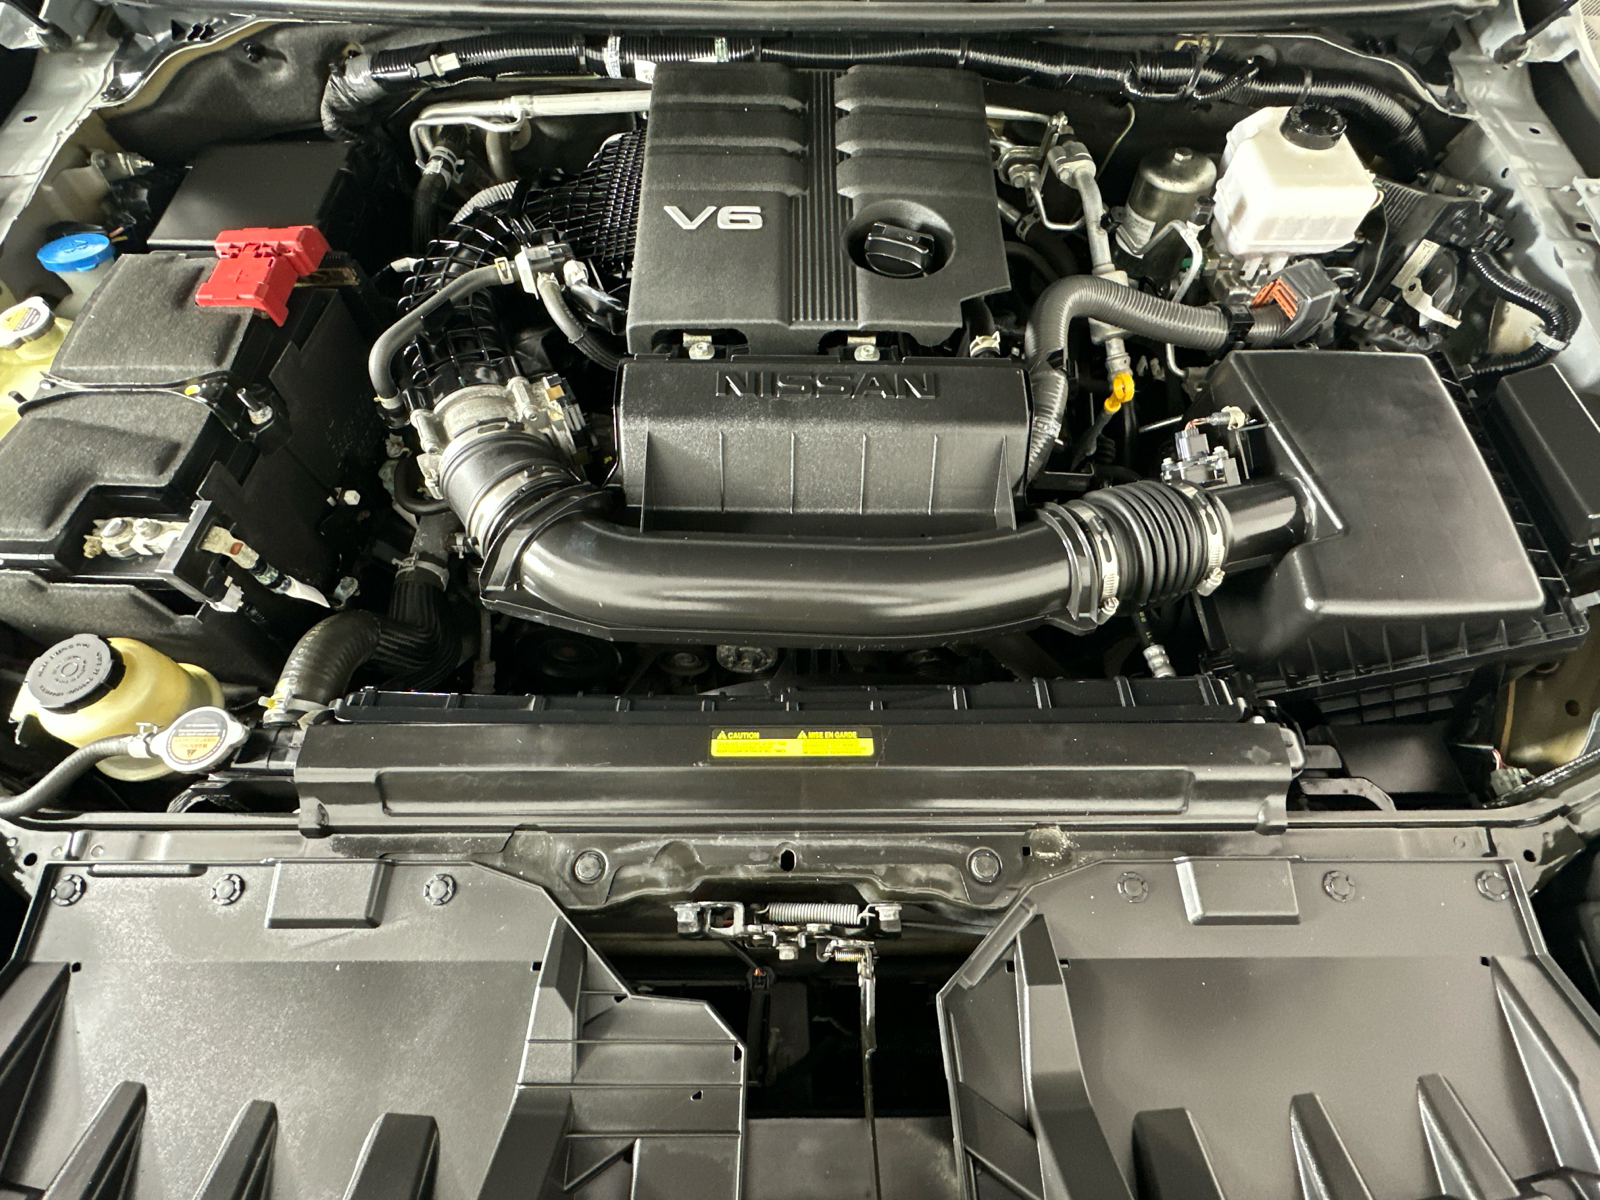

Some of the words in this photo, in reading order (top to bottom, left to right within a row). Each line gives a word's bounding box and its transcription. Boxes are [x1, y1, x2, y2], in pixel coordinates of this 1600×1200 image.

[663, 205, 763, 230] V6
[715, 370, 936, 400] NISSAN
[727, 731, 760, 739] CAUTION
[808, 731, 824, 739] MISE
[825, 731, 834, 739] EN
[834, 731, 858, 739] GARDE
